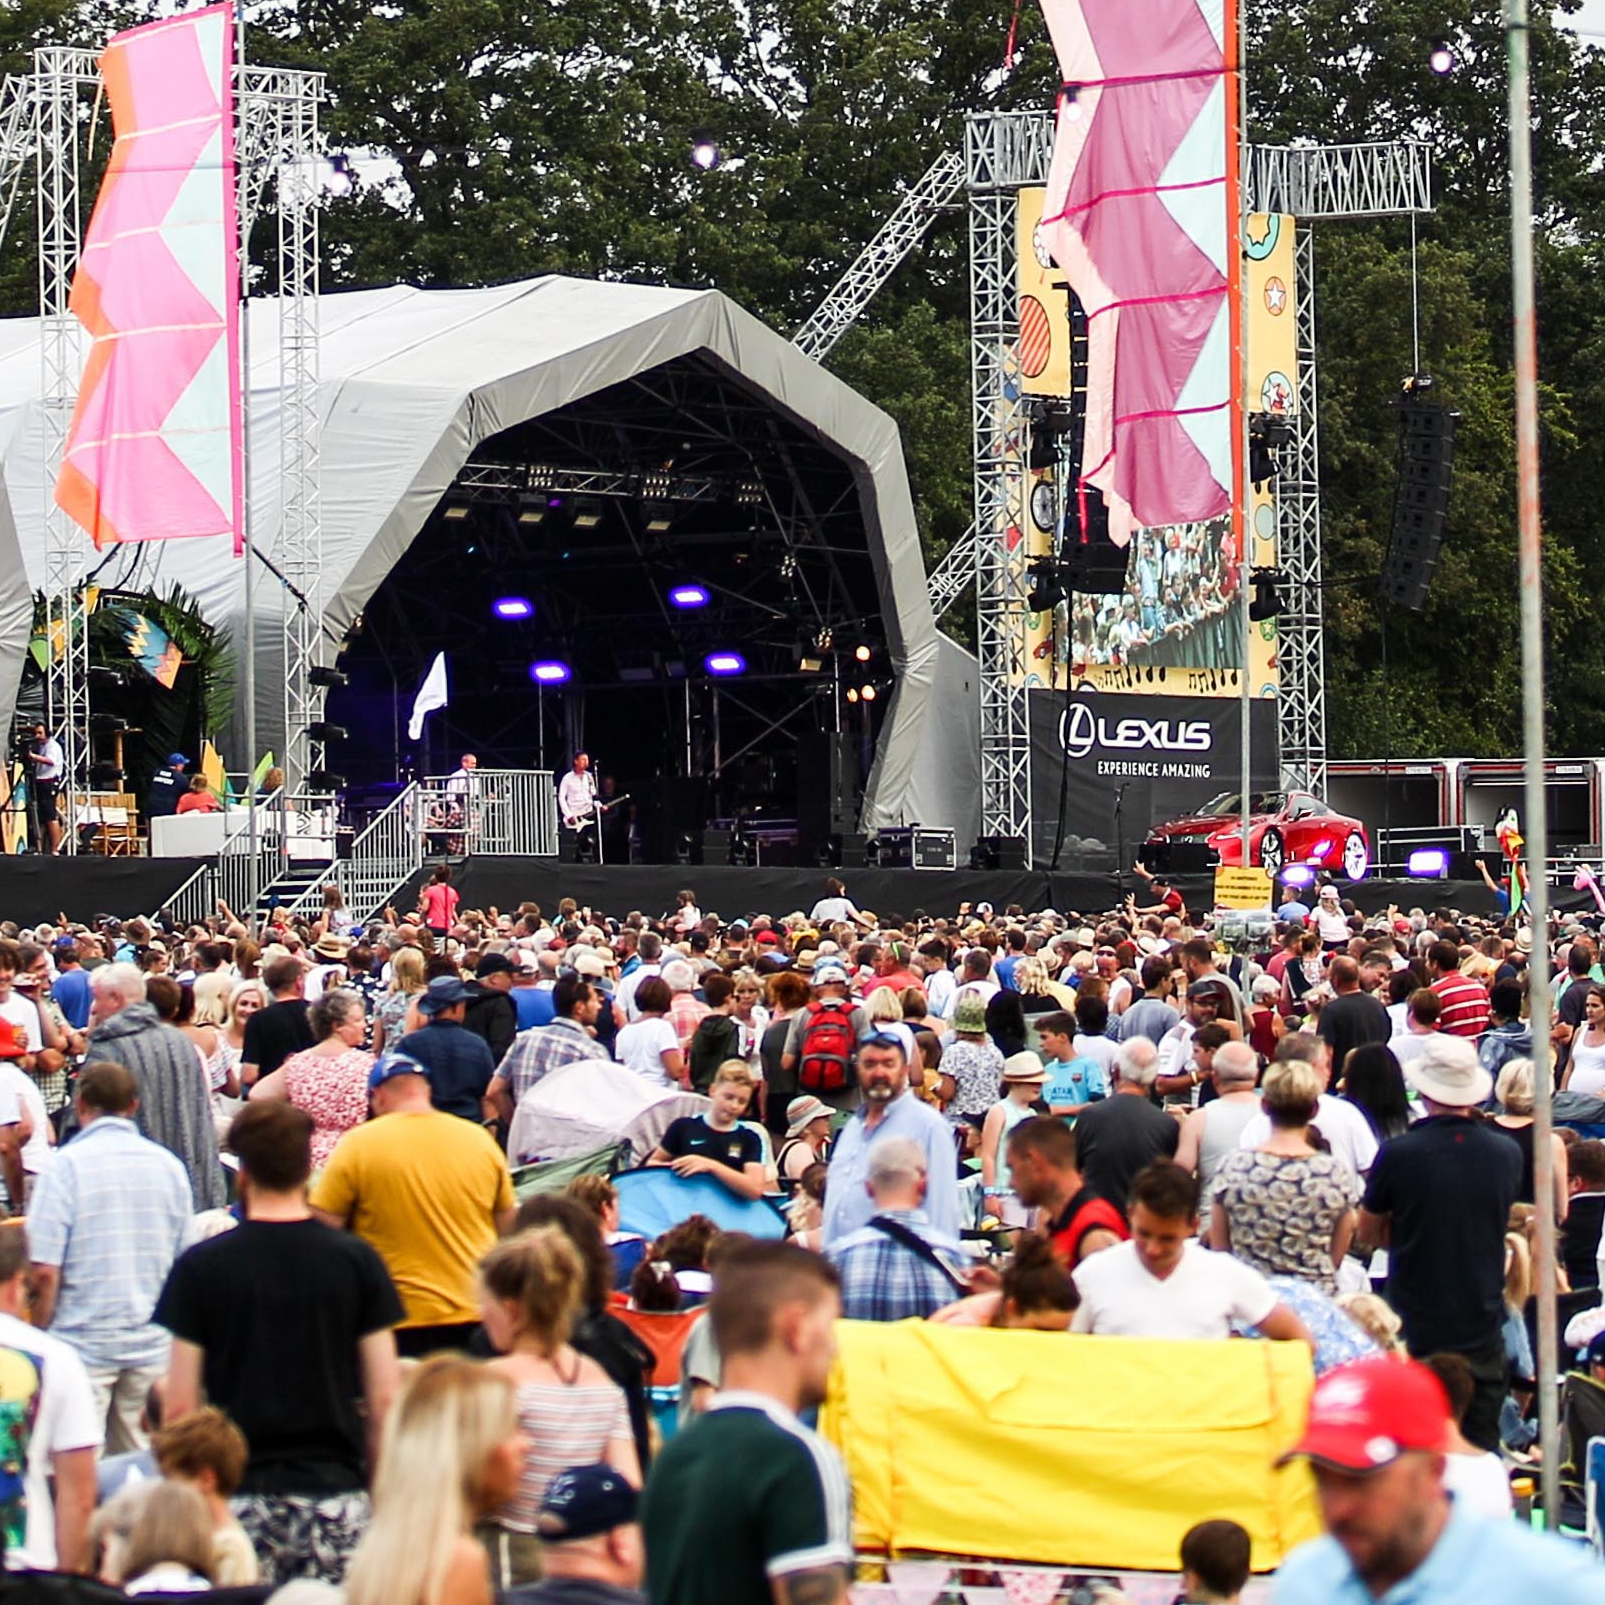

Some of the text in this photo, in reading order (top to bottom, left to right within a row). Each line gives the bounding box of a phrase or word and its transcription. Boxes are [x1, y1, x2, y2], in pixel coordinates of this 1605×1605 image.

[1097, 717, 1212, 751] LEXUS
[1097, 760, 1211, 779] EXPERIENCE AMAZING
